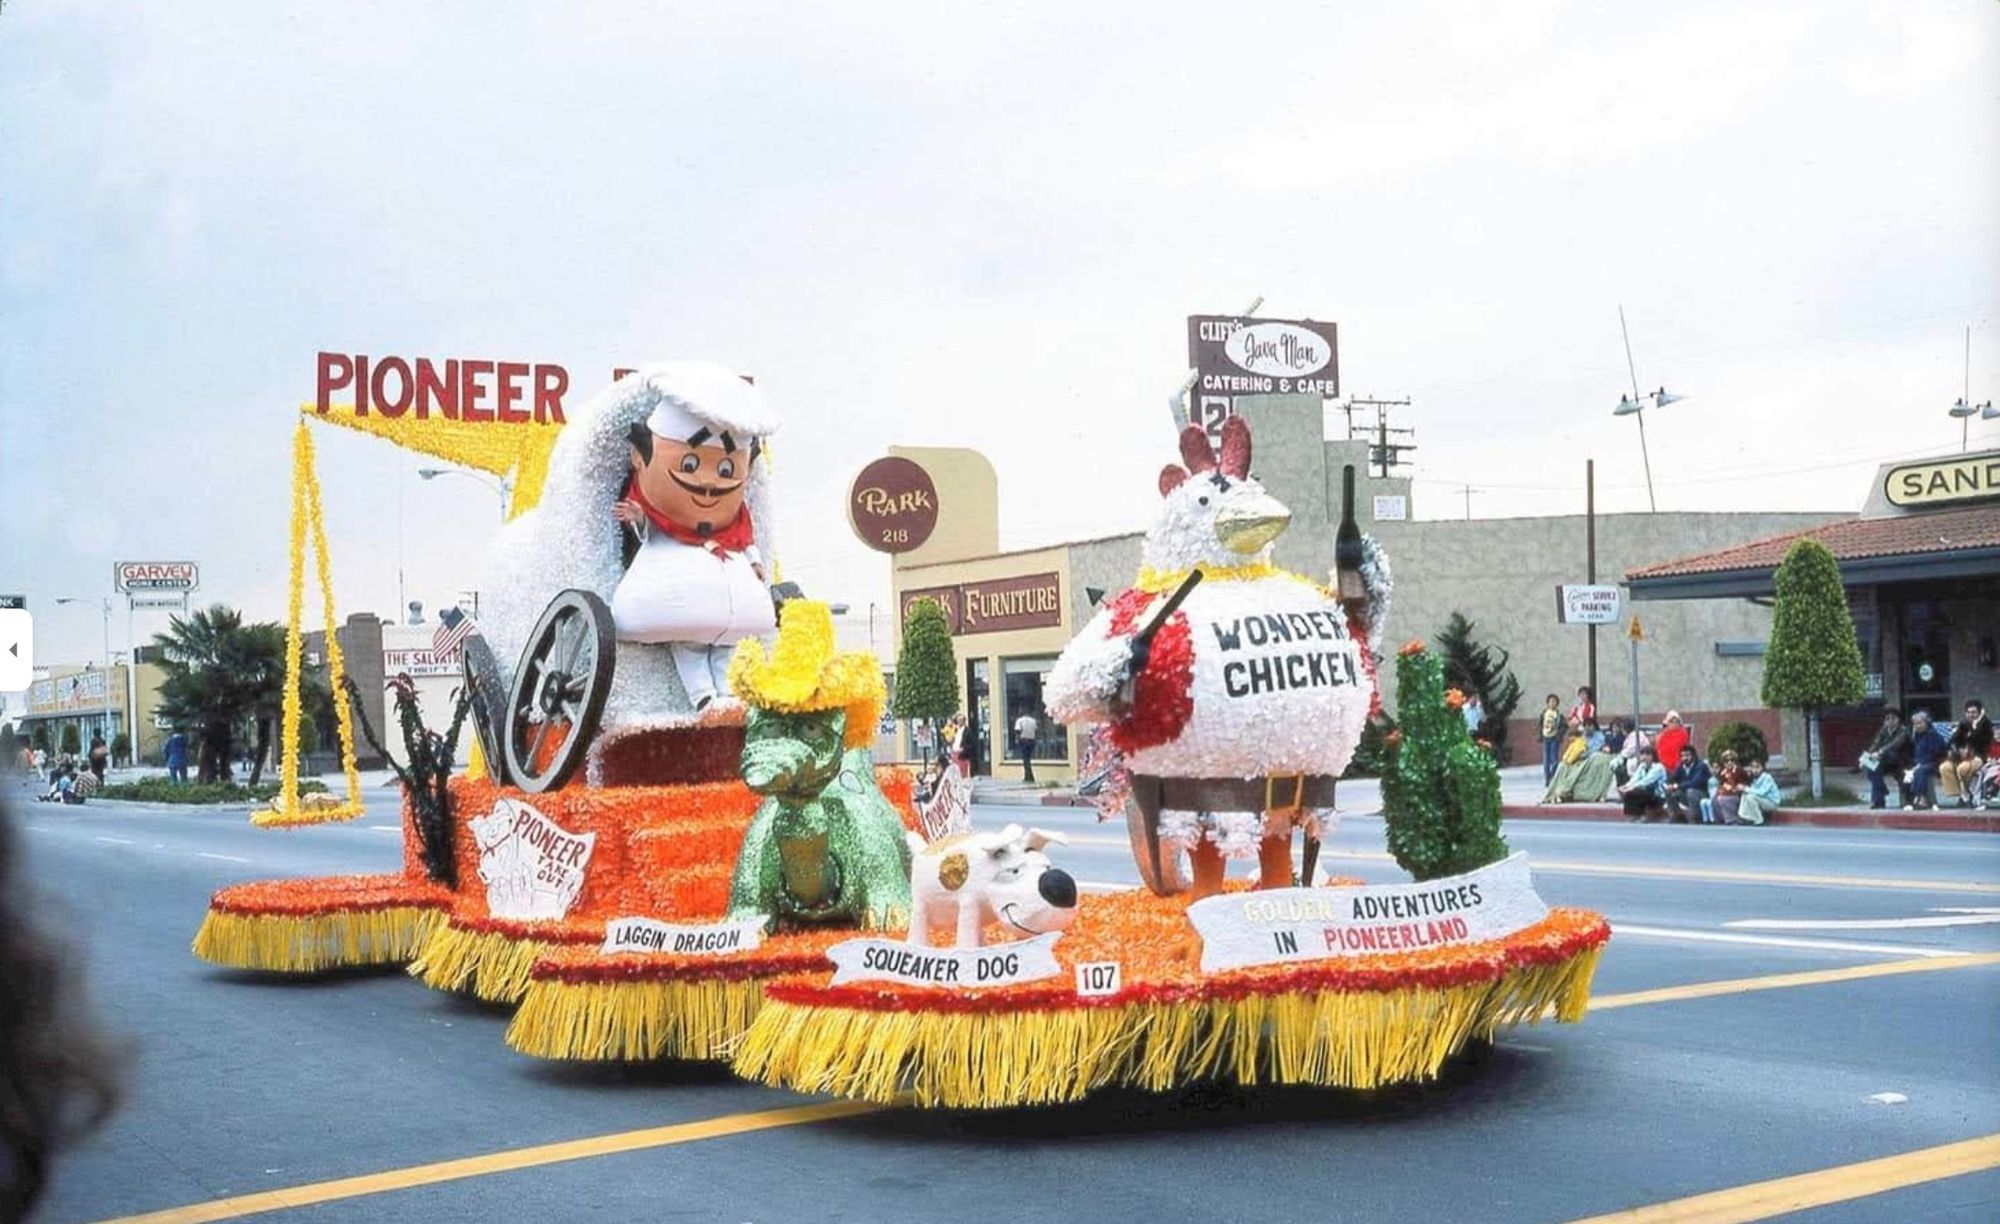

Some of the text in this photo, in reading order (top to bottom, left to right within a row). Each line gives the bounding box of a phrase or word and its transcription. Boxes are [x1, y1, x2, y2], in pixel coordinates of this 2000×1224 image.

[1244, 332, 1319, 369] Java Man
[317, 351, 569, 424] PIONEER
[1203, 375, 1335, 395] CATERING & CAFE
[858, 486, 933, 517] PARK
[882, 529, 909, 543] 218
[123, 565, 193, 579] GARVEY
[965, 586, 1057, 626] FURNITURE
[1211, 611, 1345, 651] WONDER
[387, 653, 408, 665] THE
[1224, 652, 1357, 698] CHICKEN
[513, 808, 586, 867] PIONEER
[536, 869, 563, 888] OUT
[538, 855, 568, 878] TAKE
[1244, 884, 1482, 923] GOLDEN ADVENTURES
[615, 926, 740, 951] LAGGIN DRAGON
[1274, 917, 1469, 955] IN PIONEERLAND
[863, 946, 1019, 981] SQUEAKER DOG
[1082, 966, 1115, 990] 107
